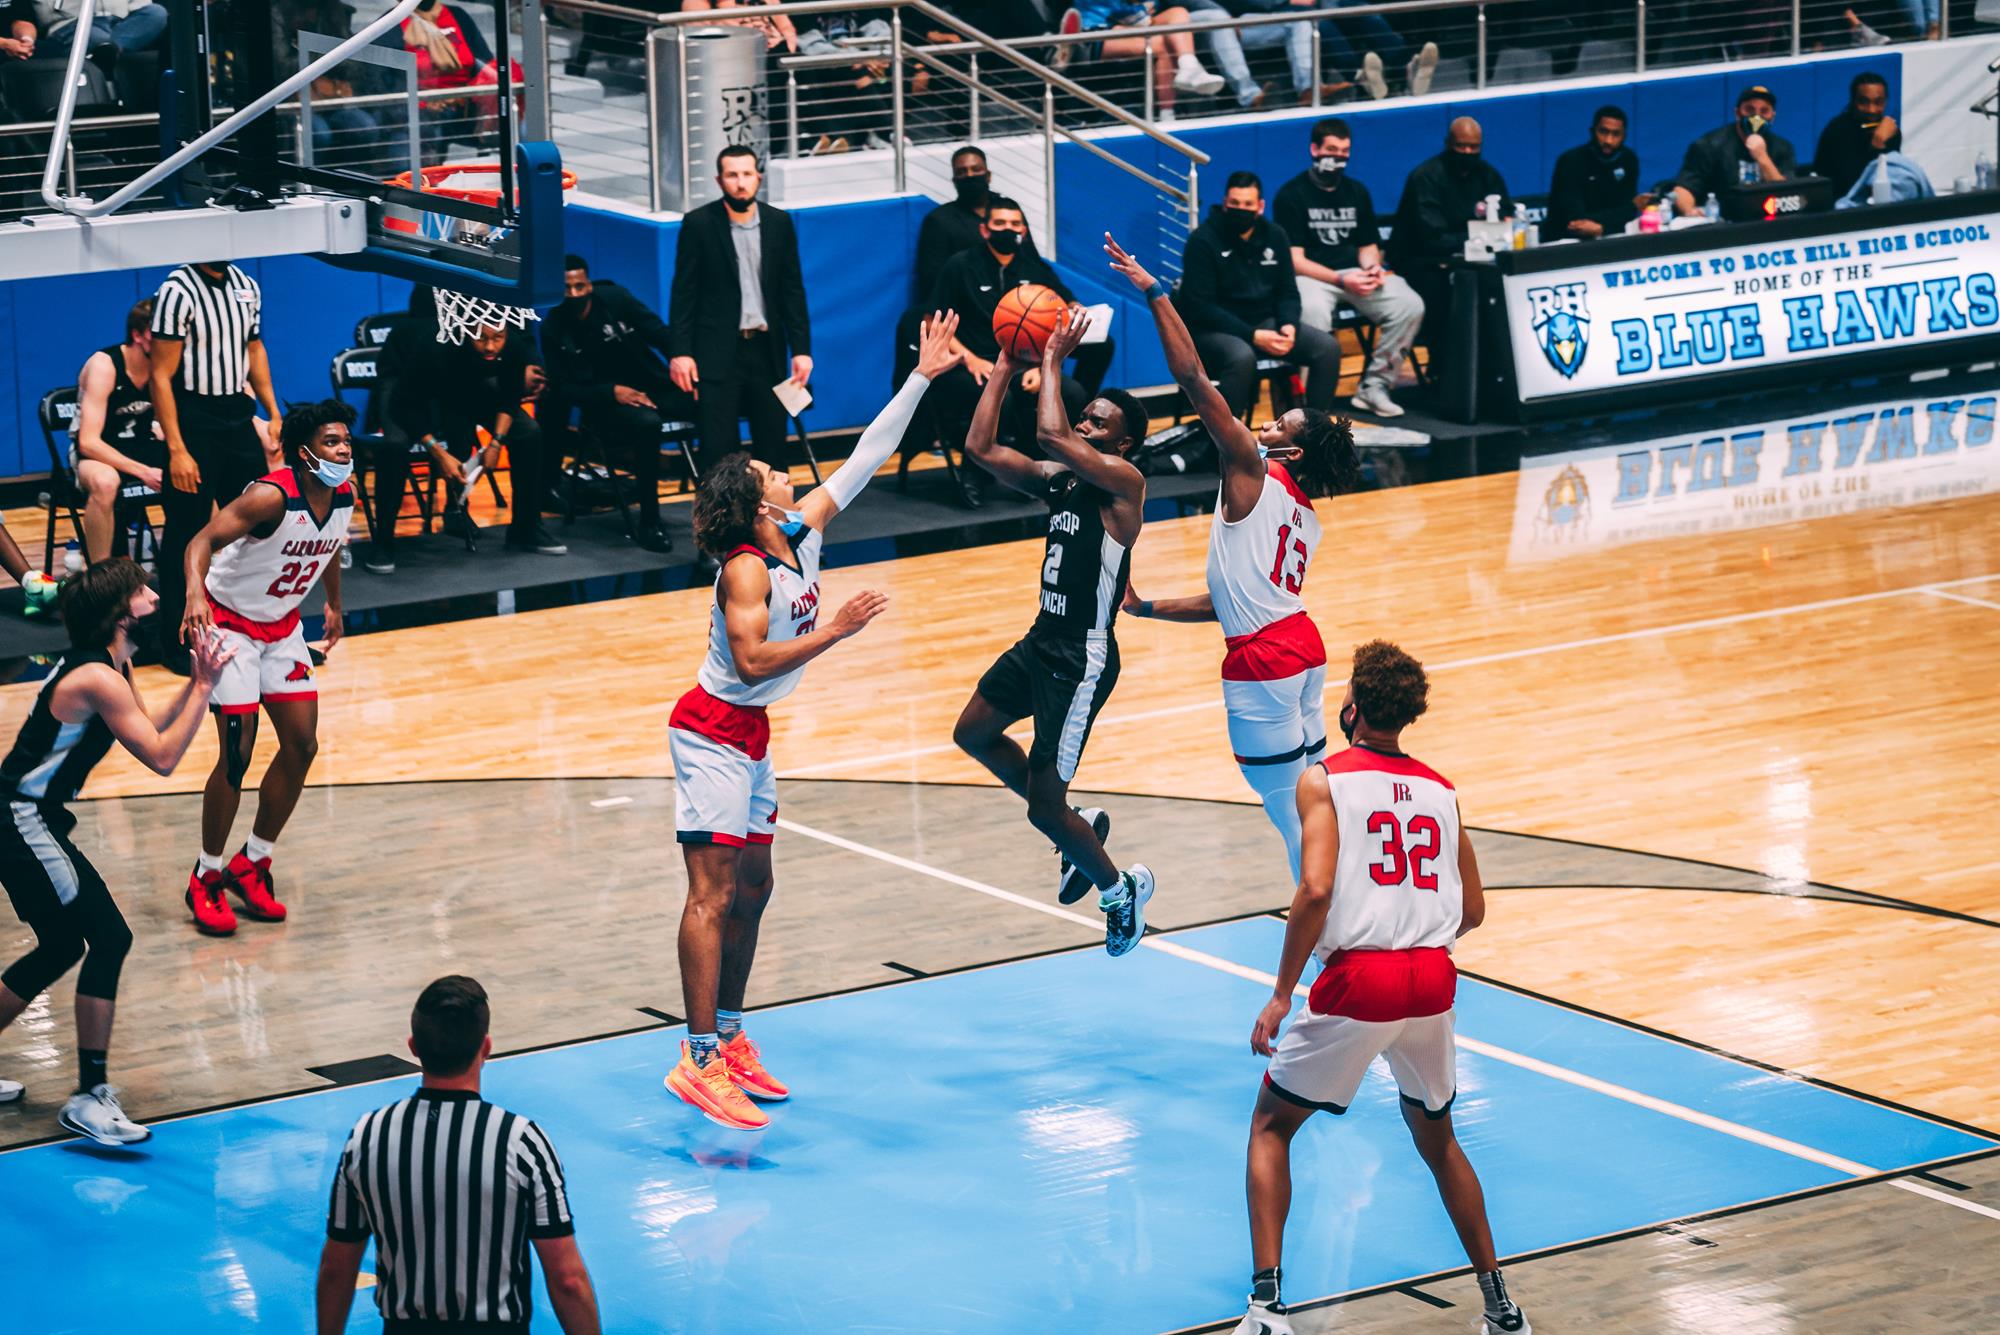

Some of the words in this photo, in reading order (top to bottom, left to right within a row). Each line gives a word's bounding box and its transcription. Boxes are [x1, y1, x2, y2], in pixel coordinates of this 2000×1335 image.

[1308, 207, 1356, 221] WYLIE
[1602, 260, 1702, 288] WELCOME
[1709, 256, 1736, 275] TO
[1743, 249, 1798, 271] ROCK
[1804, 242, 1851, 263] HILL
[1858, 235, 1908, 256] HIGH
[1914, 224, 1990, 249] SCHOOL
[1734, 273, 1792, 296] HOME
[1800, 269, 1825, 286] OF
[1833, 263, 1873, 283] THE
[1611, 302, 1765, 376] BLUE
[1782, 272, 2000, 353] HAWKS
[266, 560, 320, 598] 22
[1043, 543, 1064, 586] 2
[1269, 524, 1308, 597] 13
[1367, 811, 1441, 893] 32
